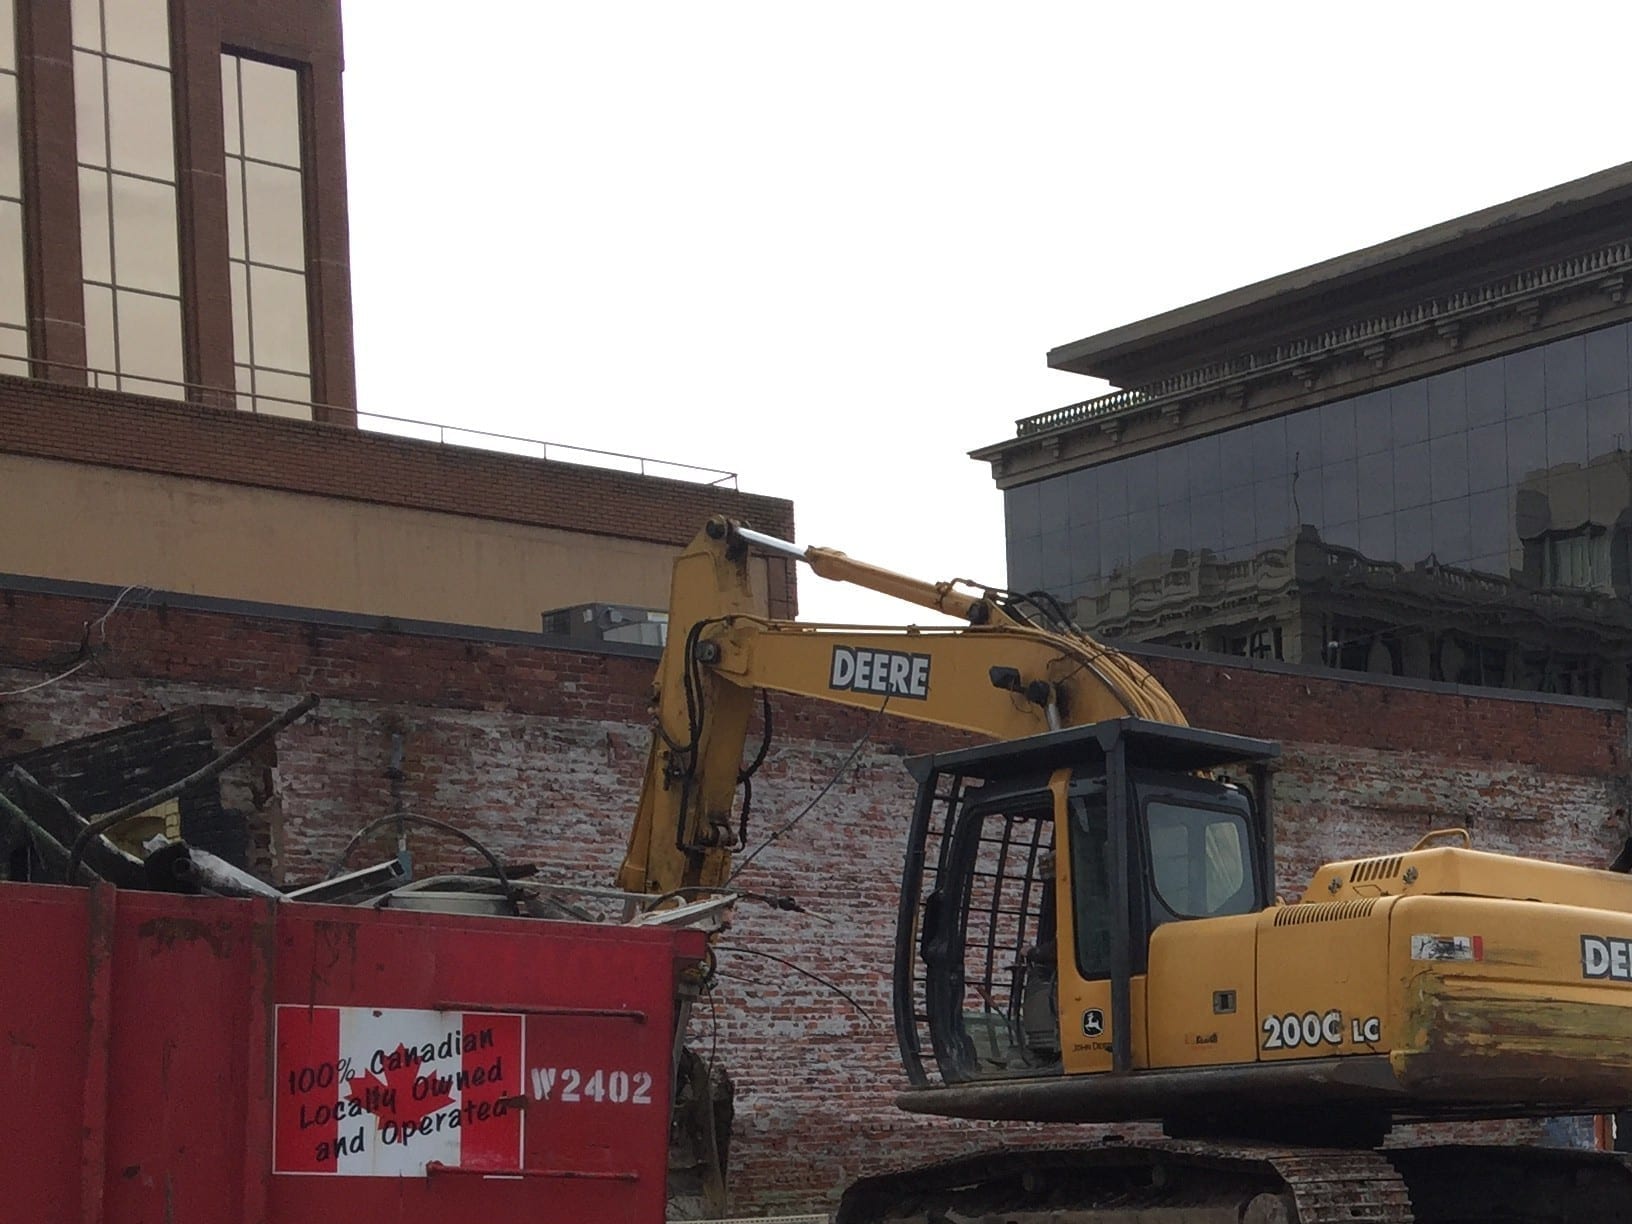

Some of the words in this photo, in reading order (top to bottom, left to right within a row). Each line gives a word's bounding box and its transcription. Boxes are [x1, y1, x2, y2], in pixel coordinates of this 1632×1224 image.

[831, 647, 930, 697] DEERE
[1262, 1011, 1342, 1049] 200C
[1352, 1017, 1380, 1042] LC
[288, 1057, 356, 1096] 100%
[369, 1027, 494, 1076] Canadian
[299, 1084, 397, 1130] Locally
[411, 1057, 503, 1101] Owned
[530, 1066, 653, 1105] W2402
[315, 1127, 365, 1162] and
